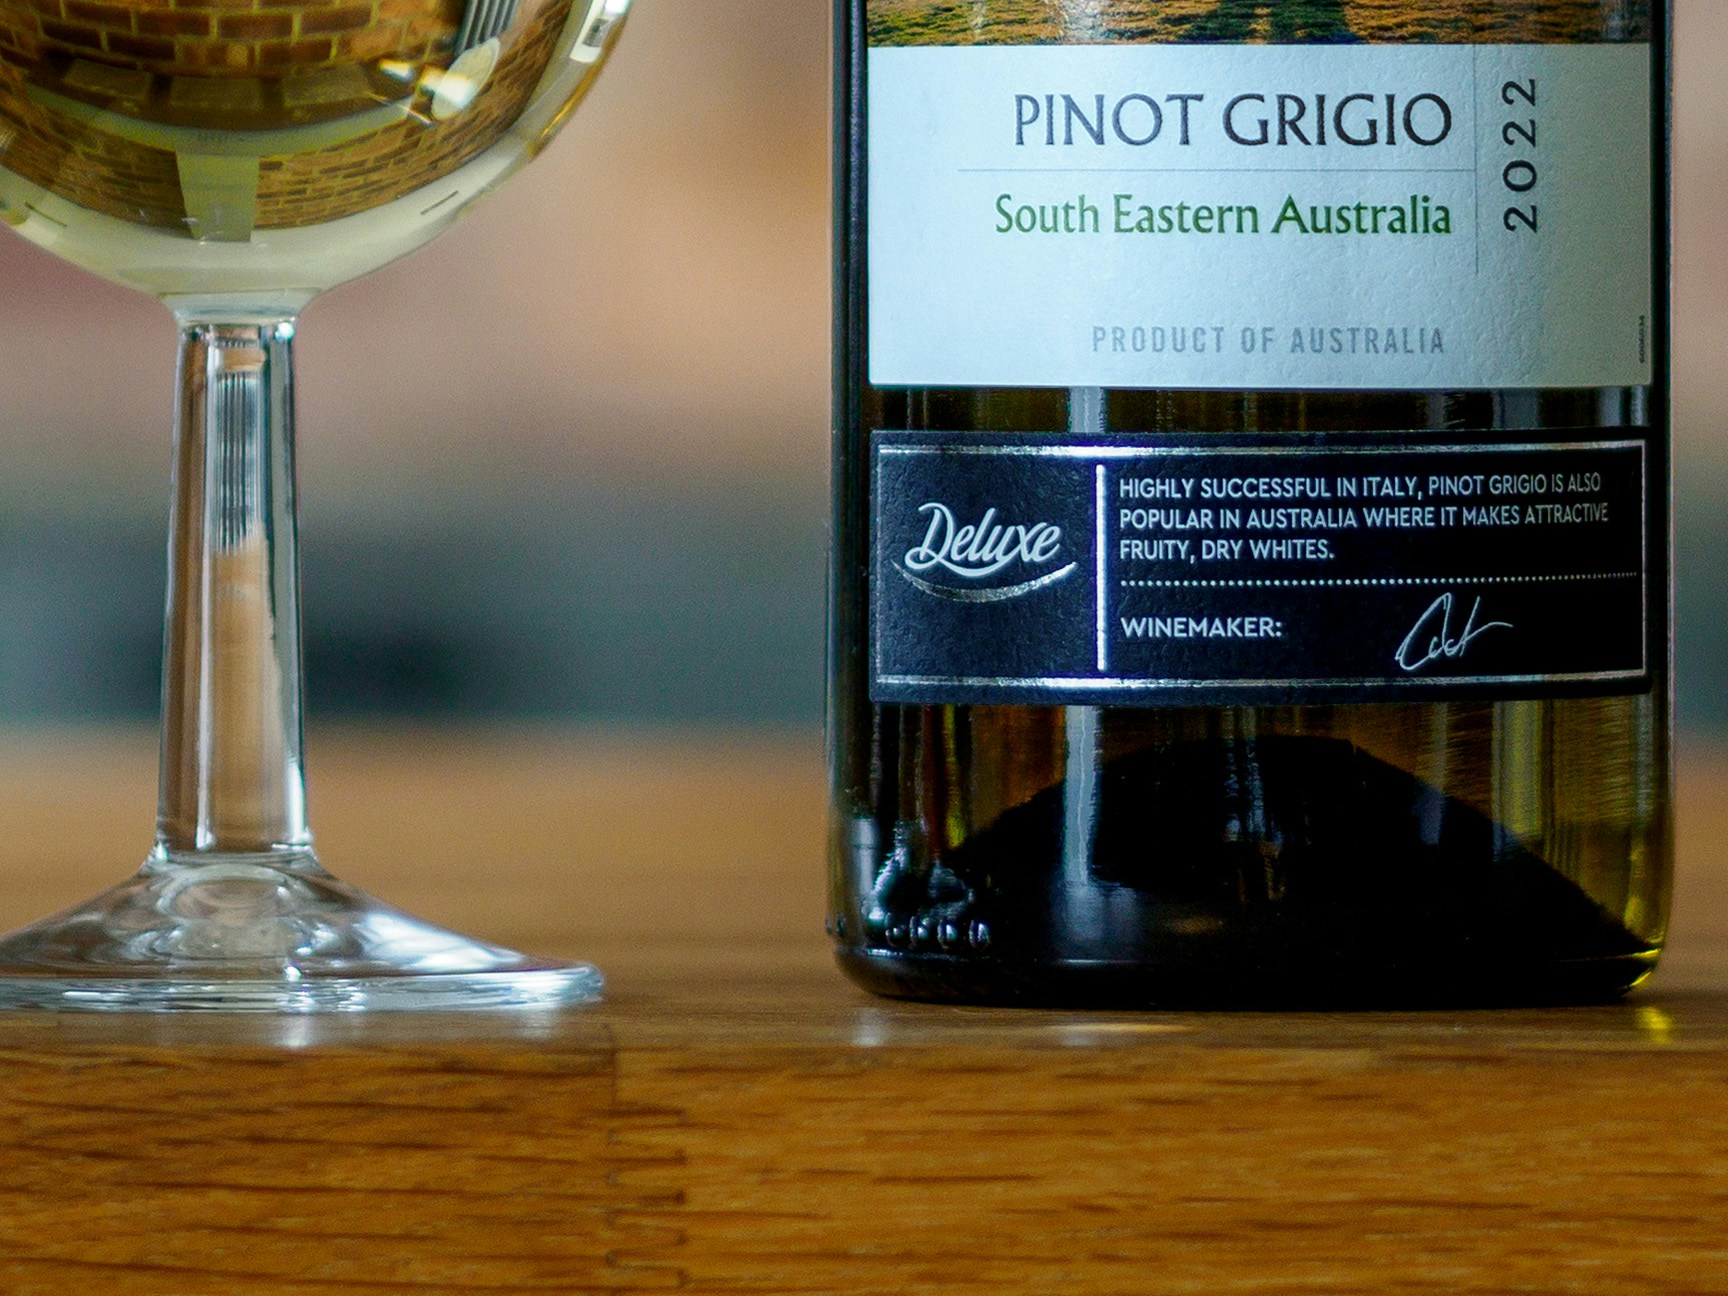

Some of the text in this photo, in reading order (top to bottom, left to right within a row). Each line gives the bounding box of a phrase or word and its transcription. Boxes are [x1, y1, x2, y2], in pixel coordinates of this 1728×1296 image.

[1014, 92, 1452, 147] PINOT GRIGIO
[1500, 78, 1538, 234] 2022
[994, 193, 1452, 235] South Eastern Australia
[1091, 325, 1445, 355] PRODUCT OF AUSTRALIA
[1119, 471, 1602, 501] HIGHLY SUCCESSFUL IN ITALY, PINOT GRIGIO IS ALSO
[1119, 501, 1610, 530] POPULAR IN AUSTRALIA WHERE IT MAKES ATTRACTIVE
[903, 501, 1062, 578] Deluxe
[1119, 538, 1336, 564] FRUITY, DRY WHITES.
[1120, 616, 1284, 638] WINEMAKER:
